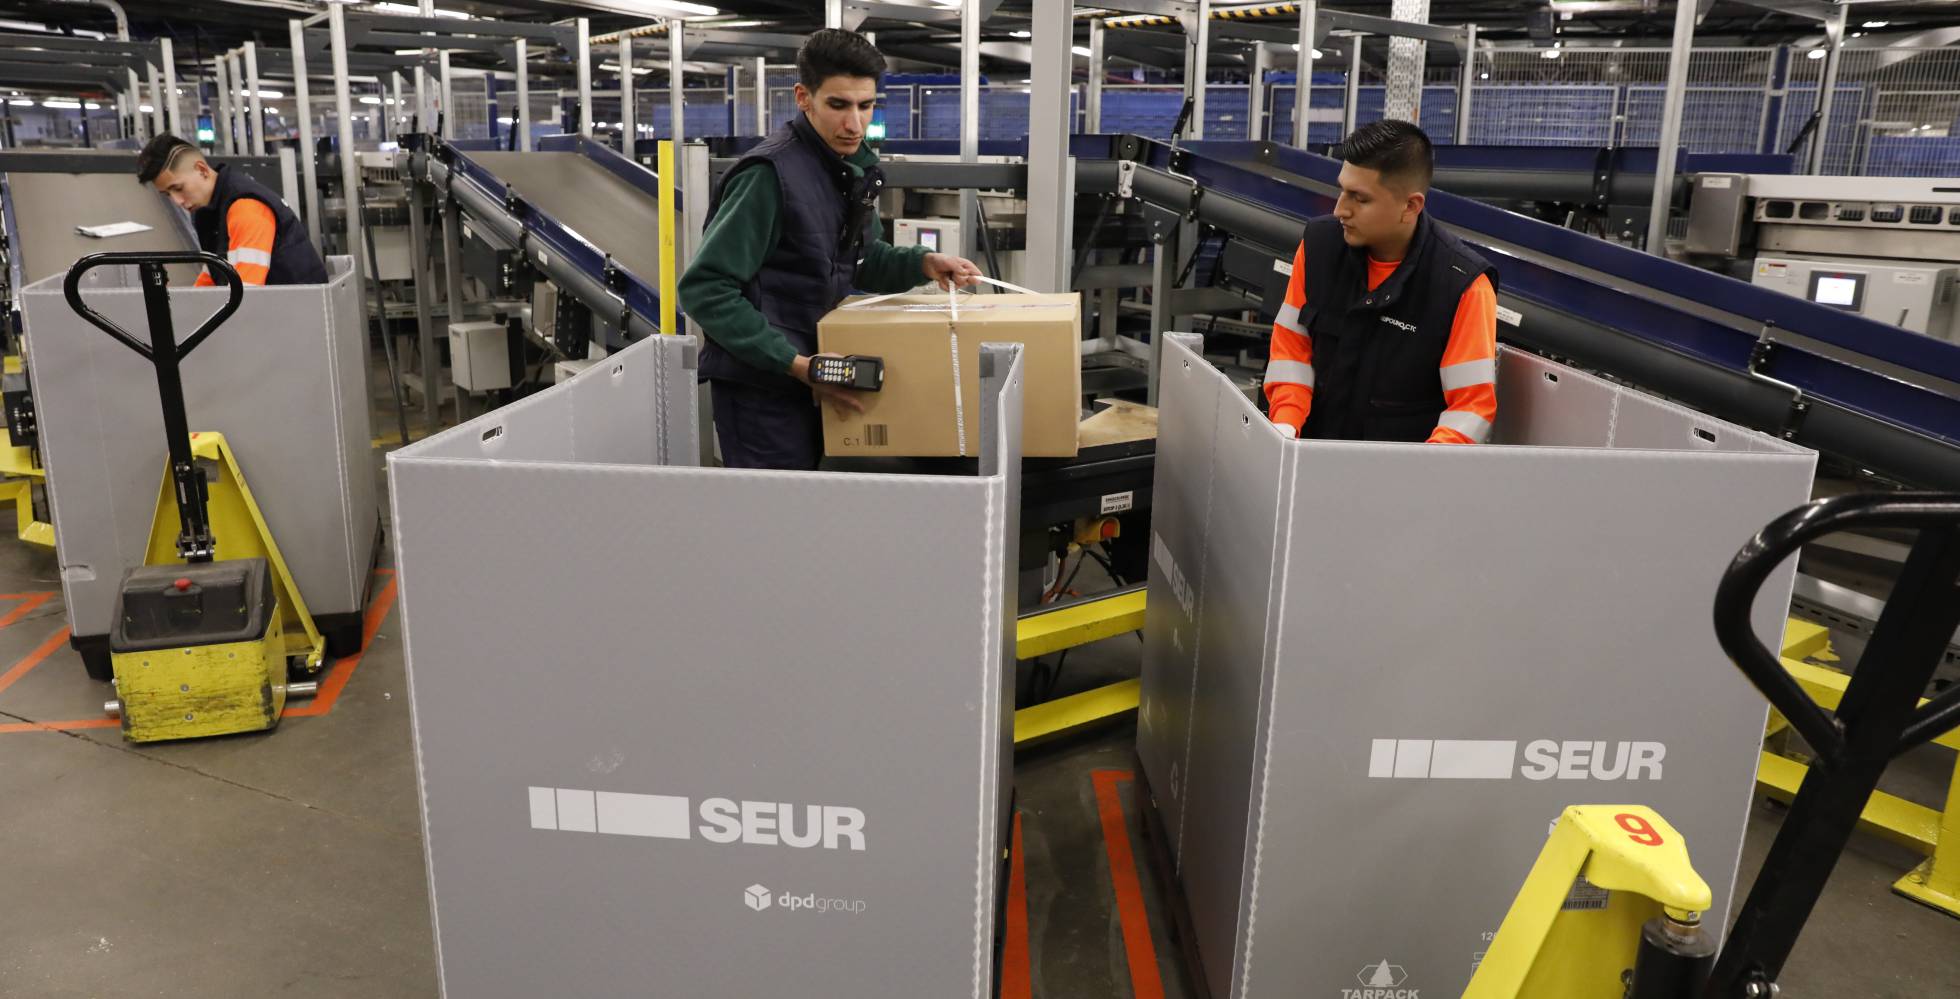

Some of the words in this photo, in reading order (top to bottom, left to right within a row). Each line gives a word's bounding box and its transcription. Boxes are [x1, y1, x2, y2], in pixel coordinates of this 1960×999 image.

[1173, 560, 1194, 624] SEUR
[1520, 739, 1667, 781] SEUR
[698, 797, 866, 851] SEUR
[1614, 813, 1665, 847] 9
[778, 891, 866, 914] dpdgroup
[1341, 988, 1420, 999] TARPACK
